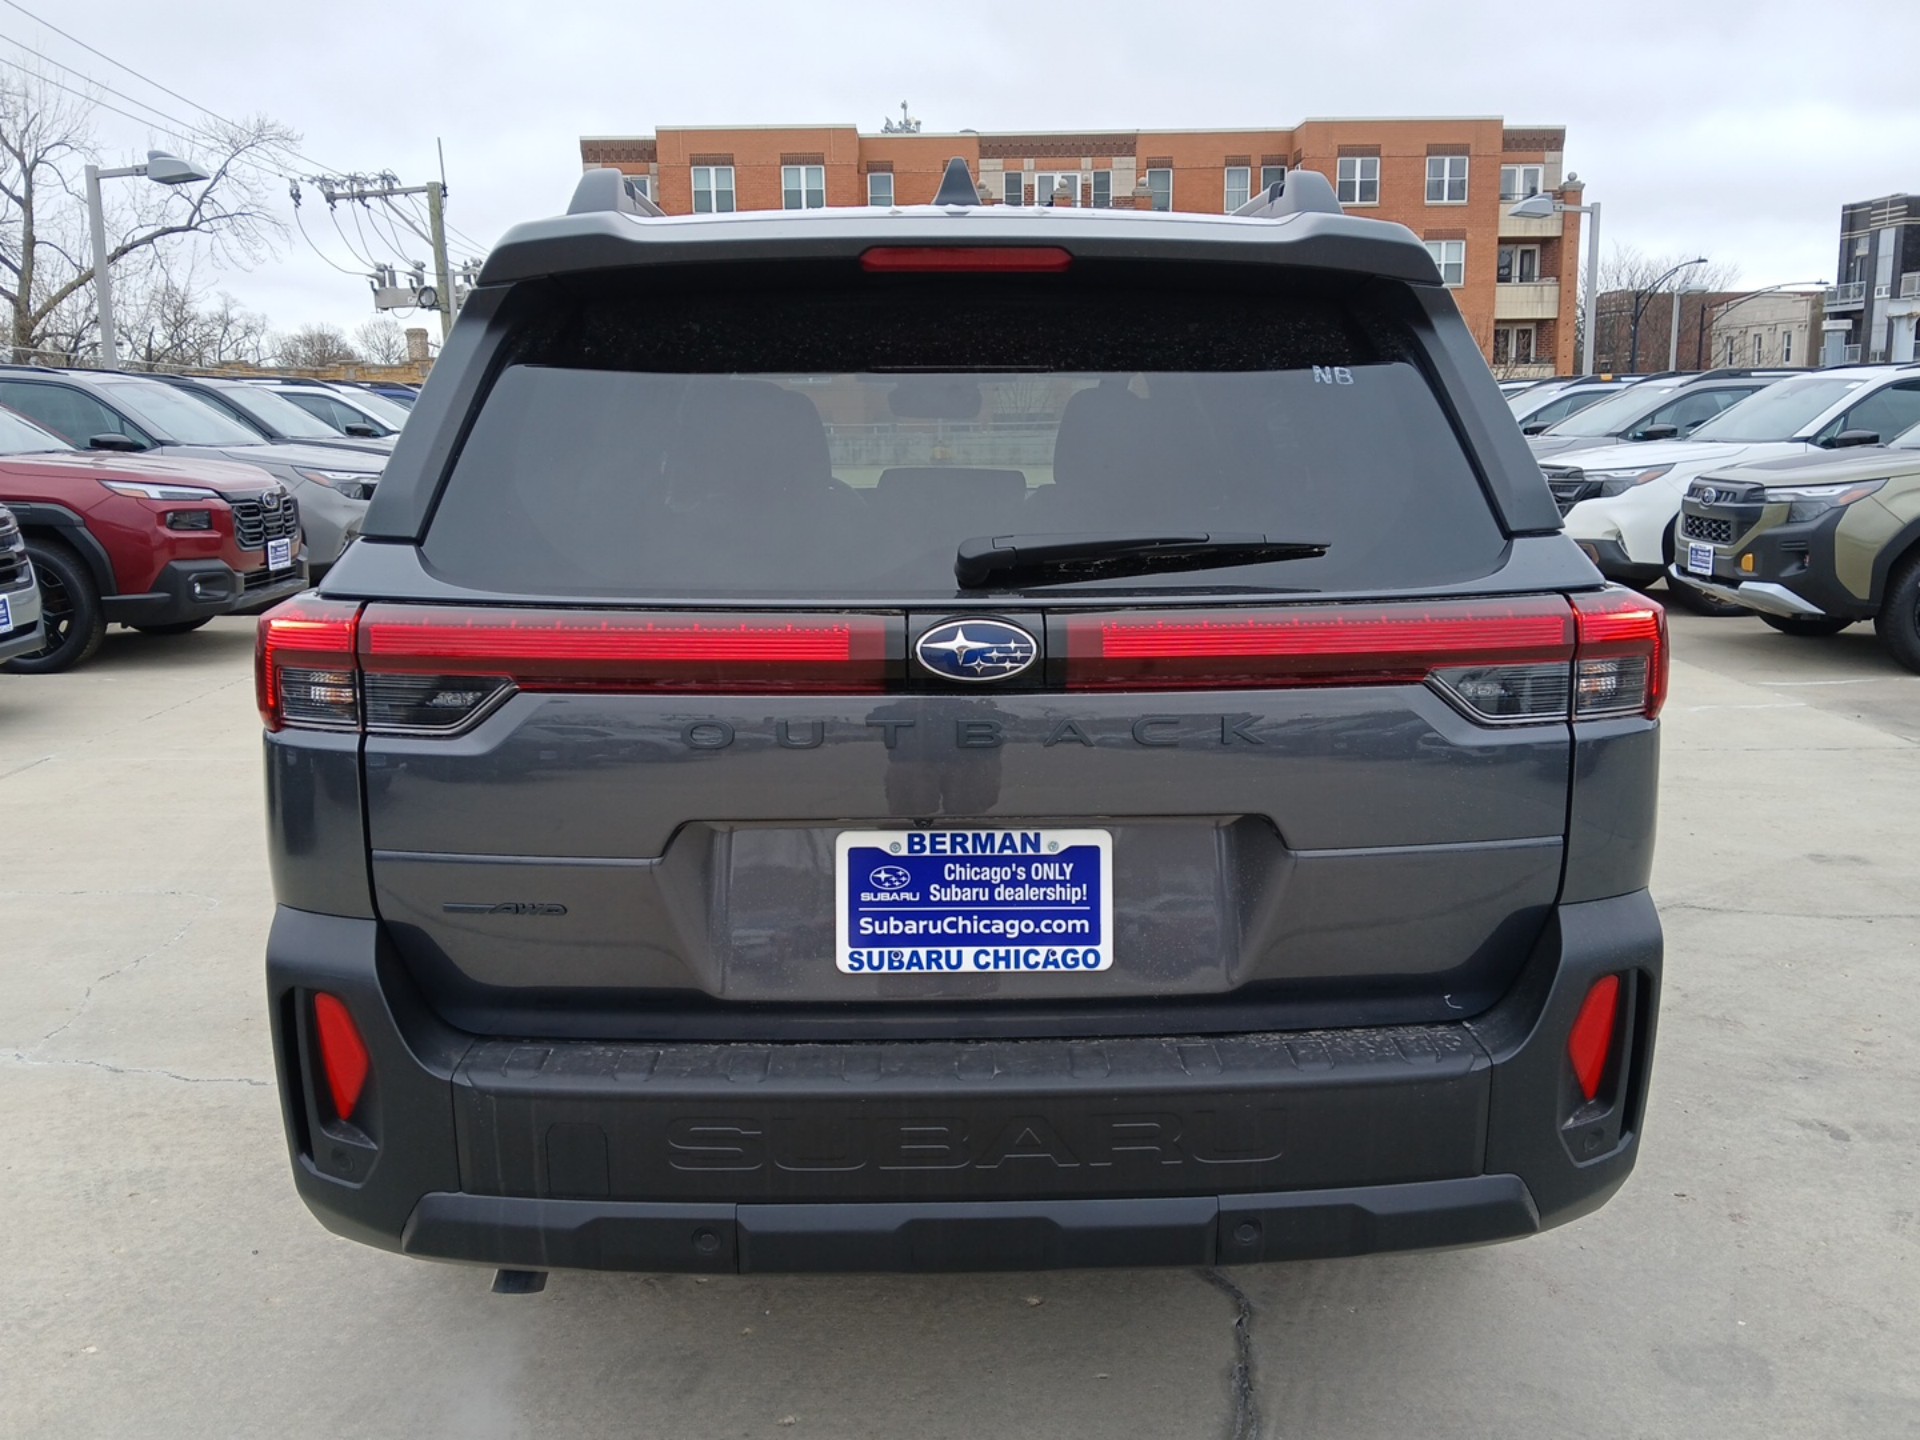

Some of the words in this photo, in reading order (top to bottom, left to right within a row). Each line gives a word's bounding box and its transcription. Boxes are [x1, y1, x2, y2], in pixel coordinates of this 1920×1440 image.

[1312, 365, 1354, 385] NB
[680, 713, 1266, 750] OUTBACK
[907, 832, 1042, 855] BERMAN
[943, 863, 1026, 884] Chicago's
[1031, 863, 1074, 881] ONLY
[860, 892, 920, 901] SUBARU
[929, 884, 990, 902] Subaru
[994, 883, 1088, 904] dealership!
[858, 915, 1090, 938] SubaruChicago.com
[847, 949, 964, 972] SUBARU
[972, 948, 1101, 970] CHICAGO
[666, 1109, 1285, 1172] SUBARU
